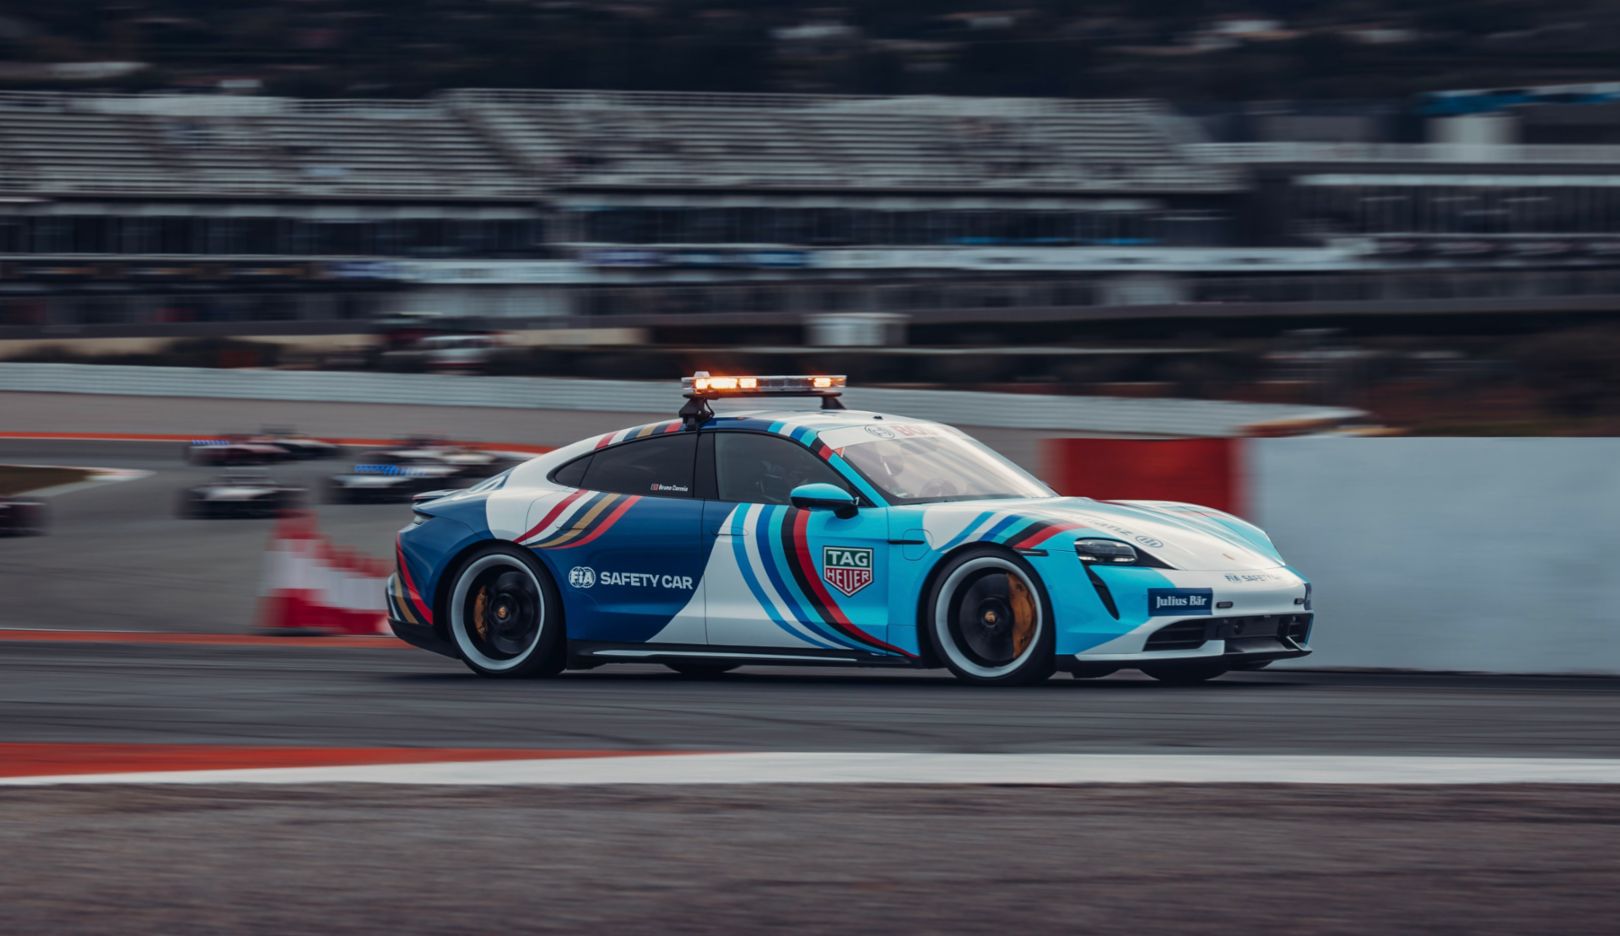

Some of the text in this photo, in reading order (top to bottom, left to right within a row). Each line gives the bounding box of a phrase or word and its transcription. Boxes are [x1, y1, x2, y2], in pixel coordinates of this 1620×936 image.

[827, 551, 868, 566] TAG
[600, 571, 659, 587] SAFETY
[661, 574, 694, 590] CAR
[826, 568, 870, 592] HEUER
[1156, 594, 1208, 609] Julius Bär
